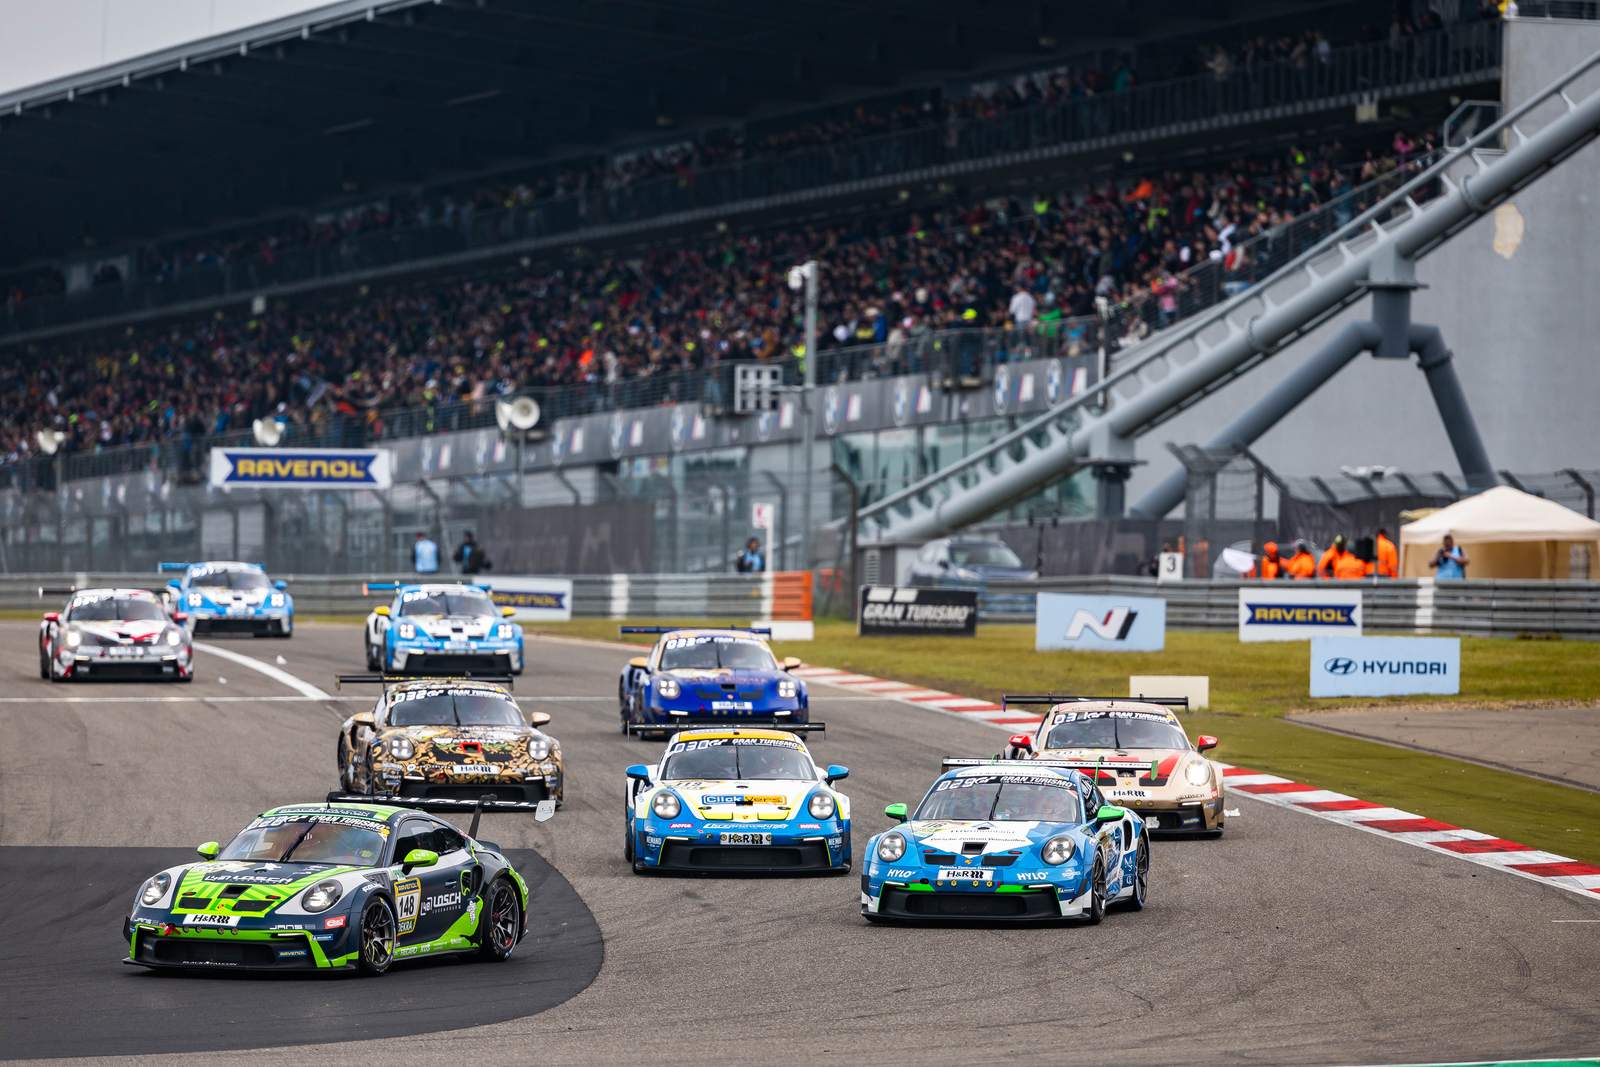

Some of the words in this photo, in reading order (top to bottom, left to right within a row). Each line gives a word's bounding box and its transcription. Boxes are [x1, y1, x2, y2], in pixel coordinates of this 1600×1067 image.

[237, 460, 365, 478] RAVENOL
[1166, 556, 1176, 572] 3
[863, 603, 906, 620] GRAN
[905, 604, 970, 622] TURISMO
[1254, 607, 1348, 622] RAVENOL
[1362, 660, 1447, 675] HYUNDAI
[394, 689, 426, 702] 032
[1109, 711, 1132, 719] GRAN
[674, 740, 709, 752] 030
[732, 738, 758, 746] GRAN
[759, 738, 798, 749] TURISMO
[937, 777, 974, 791] 029
[1000, 775, 1027, 784] GRAN
[1027, 775, 1074, 788] TURISMO
[340, 816, 385, 830] TURISMO
[946, 870, 969, 878] H&R
[1016, 872, 1046, 881] HYLO
[399, 895, 415, 917] 148
[433, 891, 461, 908] LOSCH
[192, 914, 217, 923] H&R
